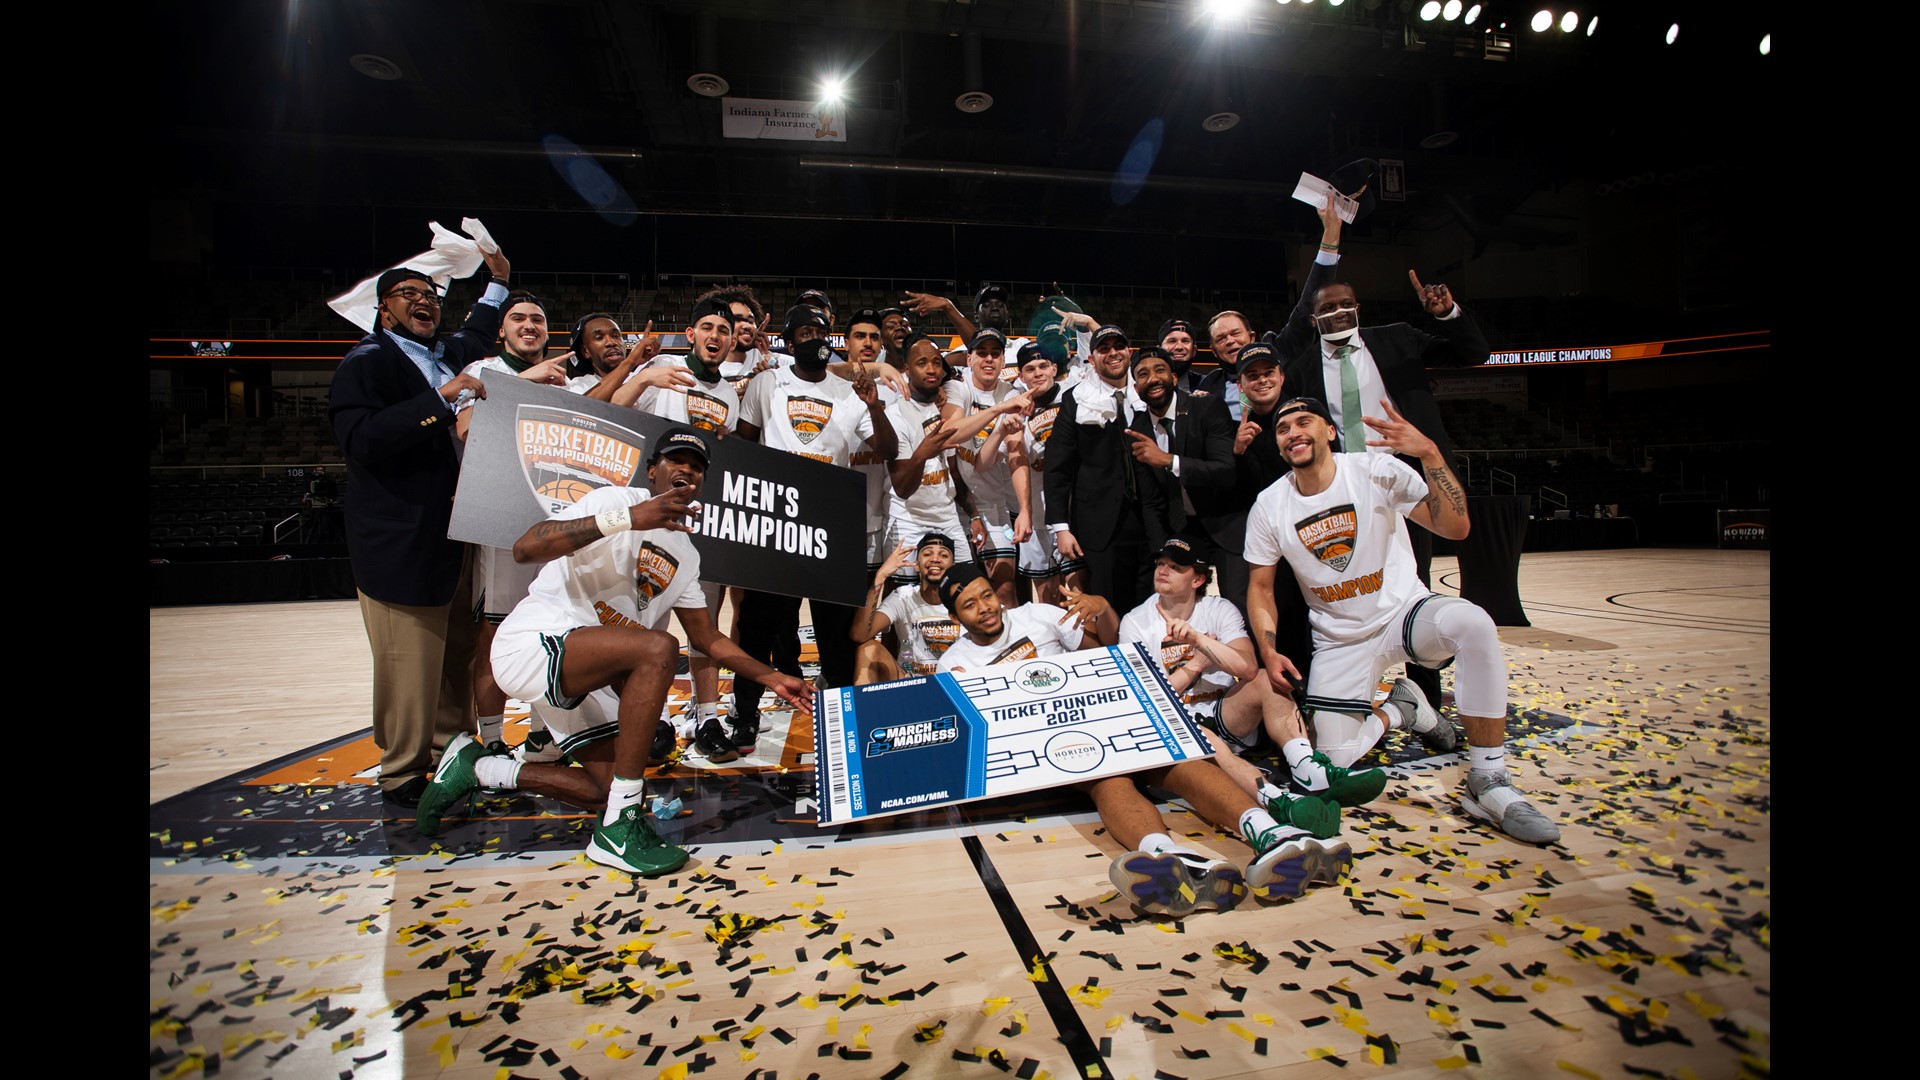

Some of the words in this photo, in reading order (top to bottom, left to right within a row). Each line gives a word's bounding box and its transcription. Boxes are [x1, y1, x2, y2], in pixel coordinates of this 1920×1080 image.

[729, 106, 771, 117] Indiana
[774, 108, 816, 119] Farmers
[765, 118, 816, 129] Insurance
[1522, 351, 1557, 363] LEAGUE
[1558, 348, 1612, 362] CHAMPIONS
[788, 400, 831, 417] BASKETBALL
[523, 421, 633, 469] BASKETBALL
[524, 444, 630, 478] CHAMPIONSHIPS
[287, 468, 304, 477] 108
[722, 470, 799, 518] MEN'S
[685, 500, 828, 559] CHAMPIONS
[1299, 512, 1355, 541] BASKETBALL
[1723, 527, 1765, 537] HORIZON
[1305, 525, 1355, 546] CHAMPIONSHIPS
[1329, 555, 1348, 565] 2021
[862, 678, 927, 693] #MARCHMADNESS
[1022, 676, 1060, 687] CLEVELAND
[843, 691, 851, 699] 21
[844, 699, 852, 713] SEAT
[991, 702, 1048, 722] TICKET
[1052, 689, 1129, 712] PUNCHED
[1046, 708, 1087, 726] 2021
[1144, 701, 1170, 738] TOURNAMENT
[846, 730, 855, 739] 14
[886, 722, 932, 739] MARCH
[893, 728, 956, 748] MADNESS
[848, 739, 856, 754] ROW
[1054, 746, 1096, 758] HORIZON
[1167, 737, 1181, 755] NCAA
[852, 781, 862, 811] SECTION
[881, 790, 950, 809] NCAA.COM/MML
